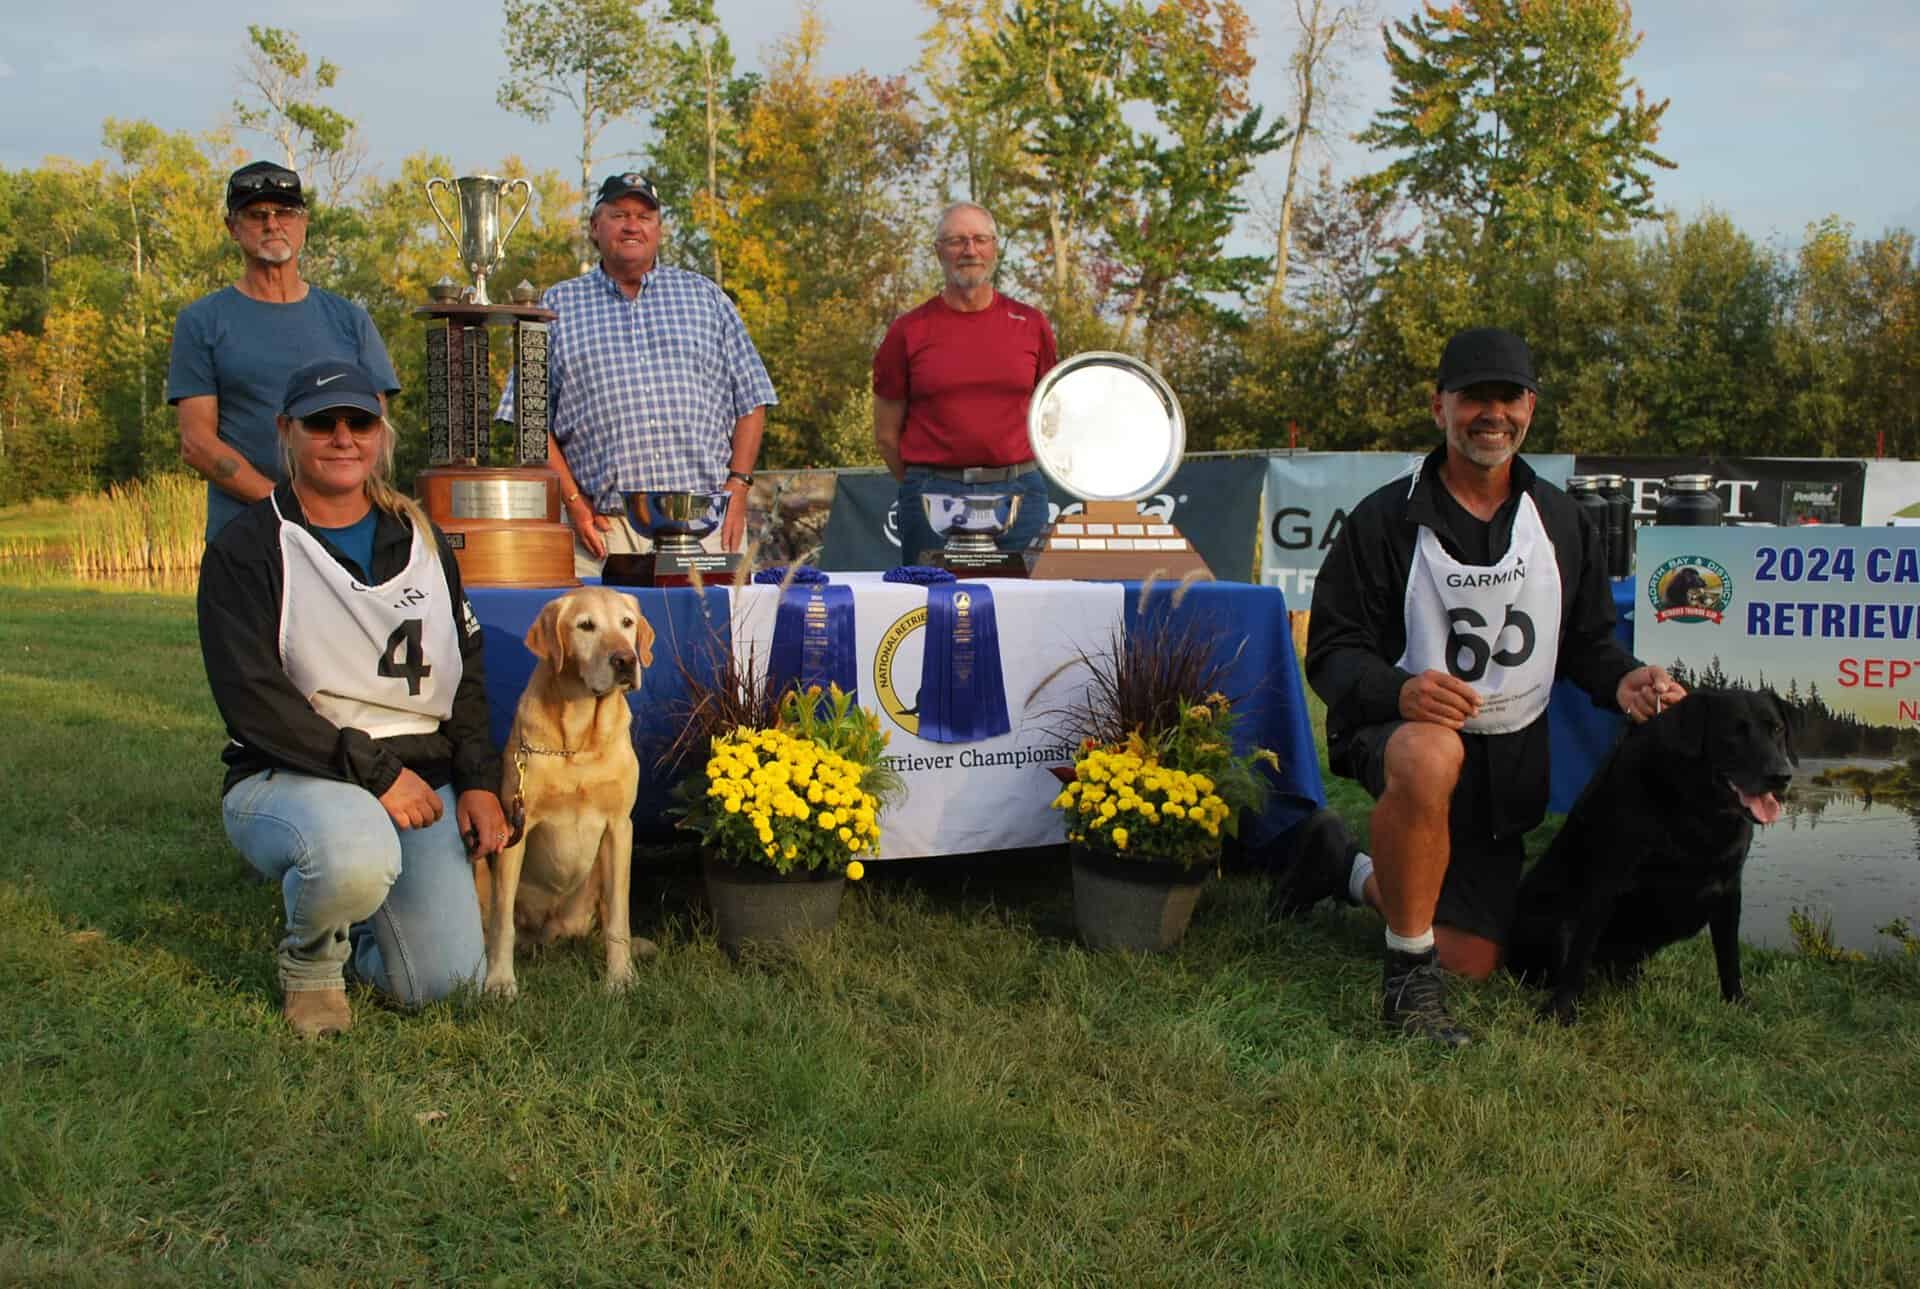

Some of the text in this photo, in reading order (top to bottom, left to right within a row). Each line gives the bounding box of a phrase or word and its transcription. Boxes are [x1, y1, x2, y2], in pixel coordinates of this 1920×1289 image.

[1446, 565, 1526, 588] GARMIN
[1755, 547, 1855, 582] 2024
[1748, 602, 1920, 640] RETRIEV
[377, 618, 432, 697] 4
[878, 610, 929, 689] NATIONAL RETRIE
